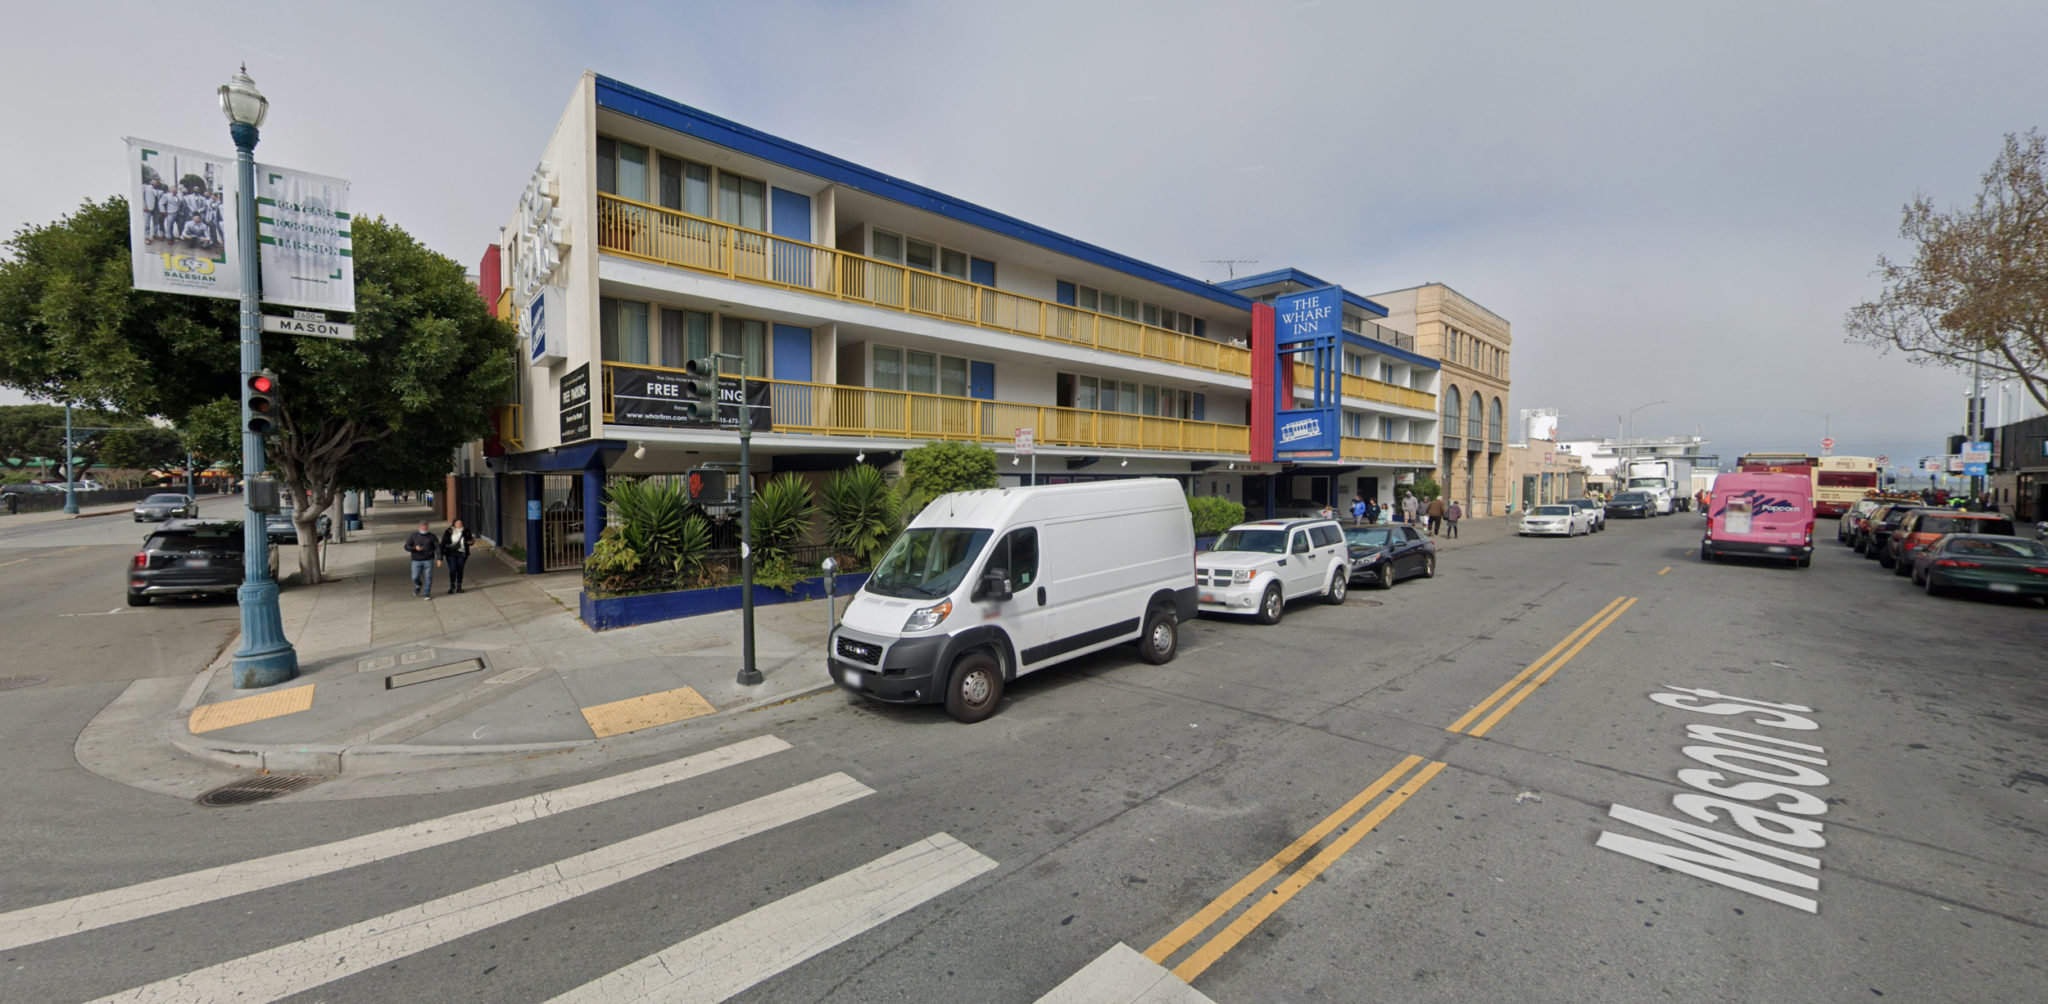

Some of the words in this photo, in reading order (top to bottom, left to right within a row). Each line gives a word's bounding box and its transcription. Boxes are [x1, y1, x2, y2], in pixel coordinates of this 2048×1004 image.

[298, 204, 336, 218] YEARS
[282, 239, 340, 256] MISSION
[164, 271, 216, 281] SALESIAN
[1292, 296, 1320, 311] THE
[1282, 306, 1332, 325] WHARF
[280, 321, 339, 335] MASON
[1293, 321, 1319, 335] INN
[647, 382, 679, 397] FREE
[1761, 504, 1800, 513] Popcorn
